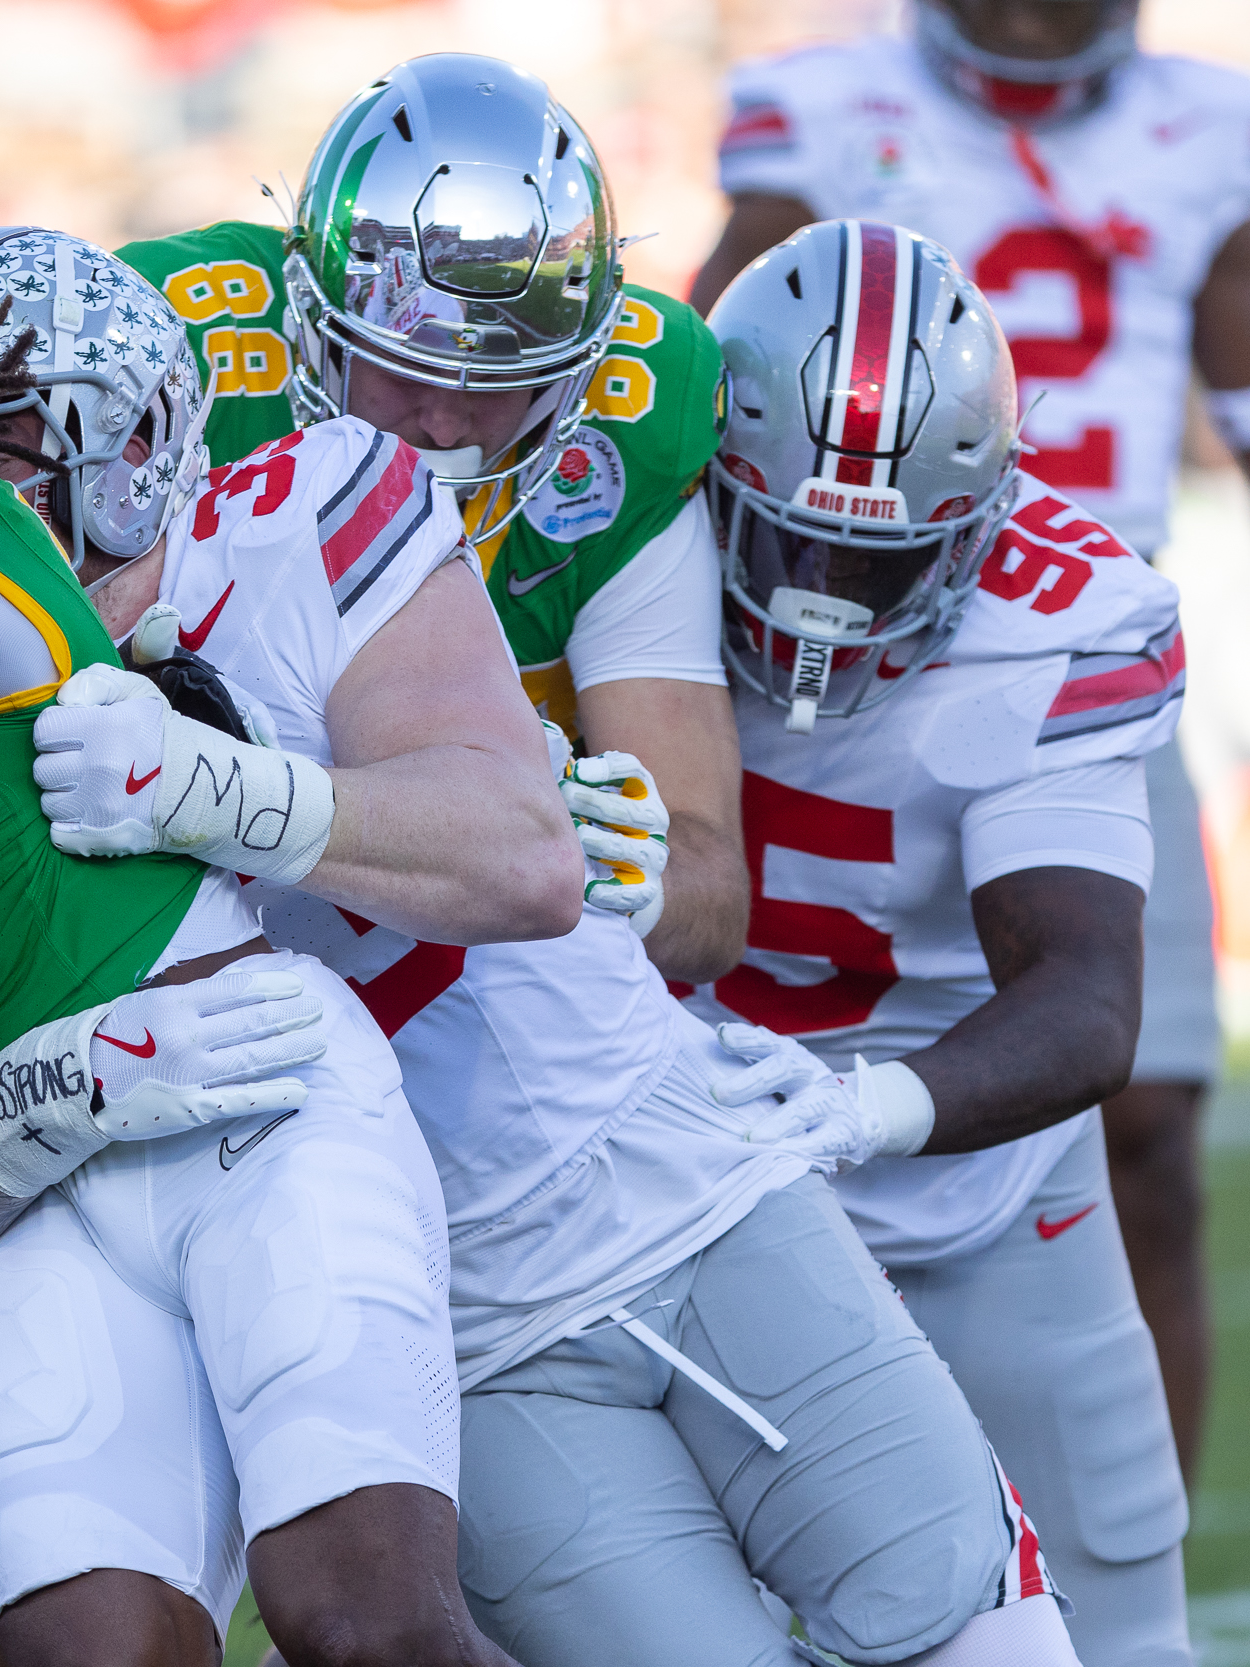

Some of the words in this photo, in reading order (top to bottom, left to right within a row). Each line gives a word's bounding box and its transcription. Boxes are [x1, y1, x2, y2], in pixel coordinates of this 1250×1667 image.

[161, 259, 295, 399] 88
[594, 440, 622, 488] GAME
[807, 487, 846, 514] OHIO
[849, 496, 897, 520] STATE
[977, 495, 1134, 616] 95
